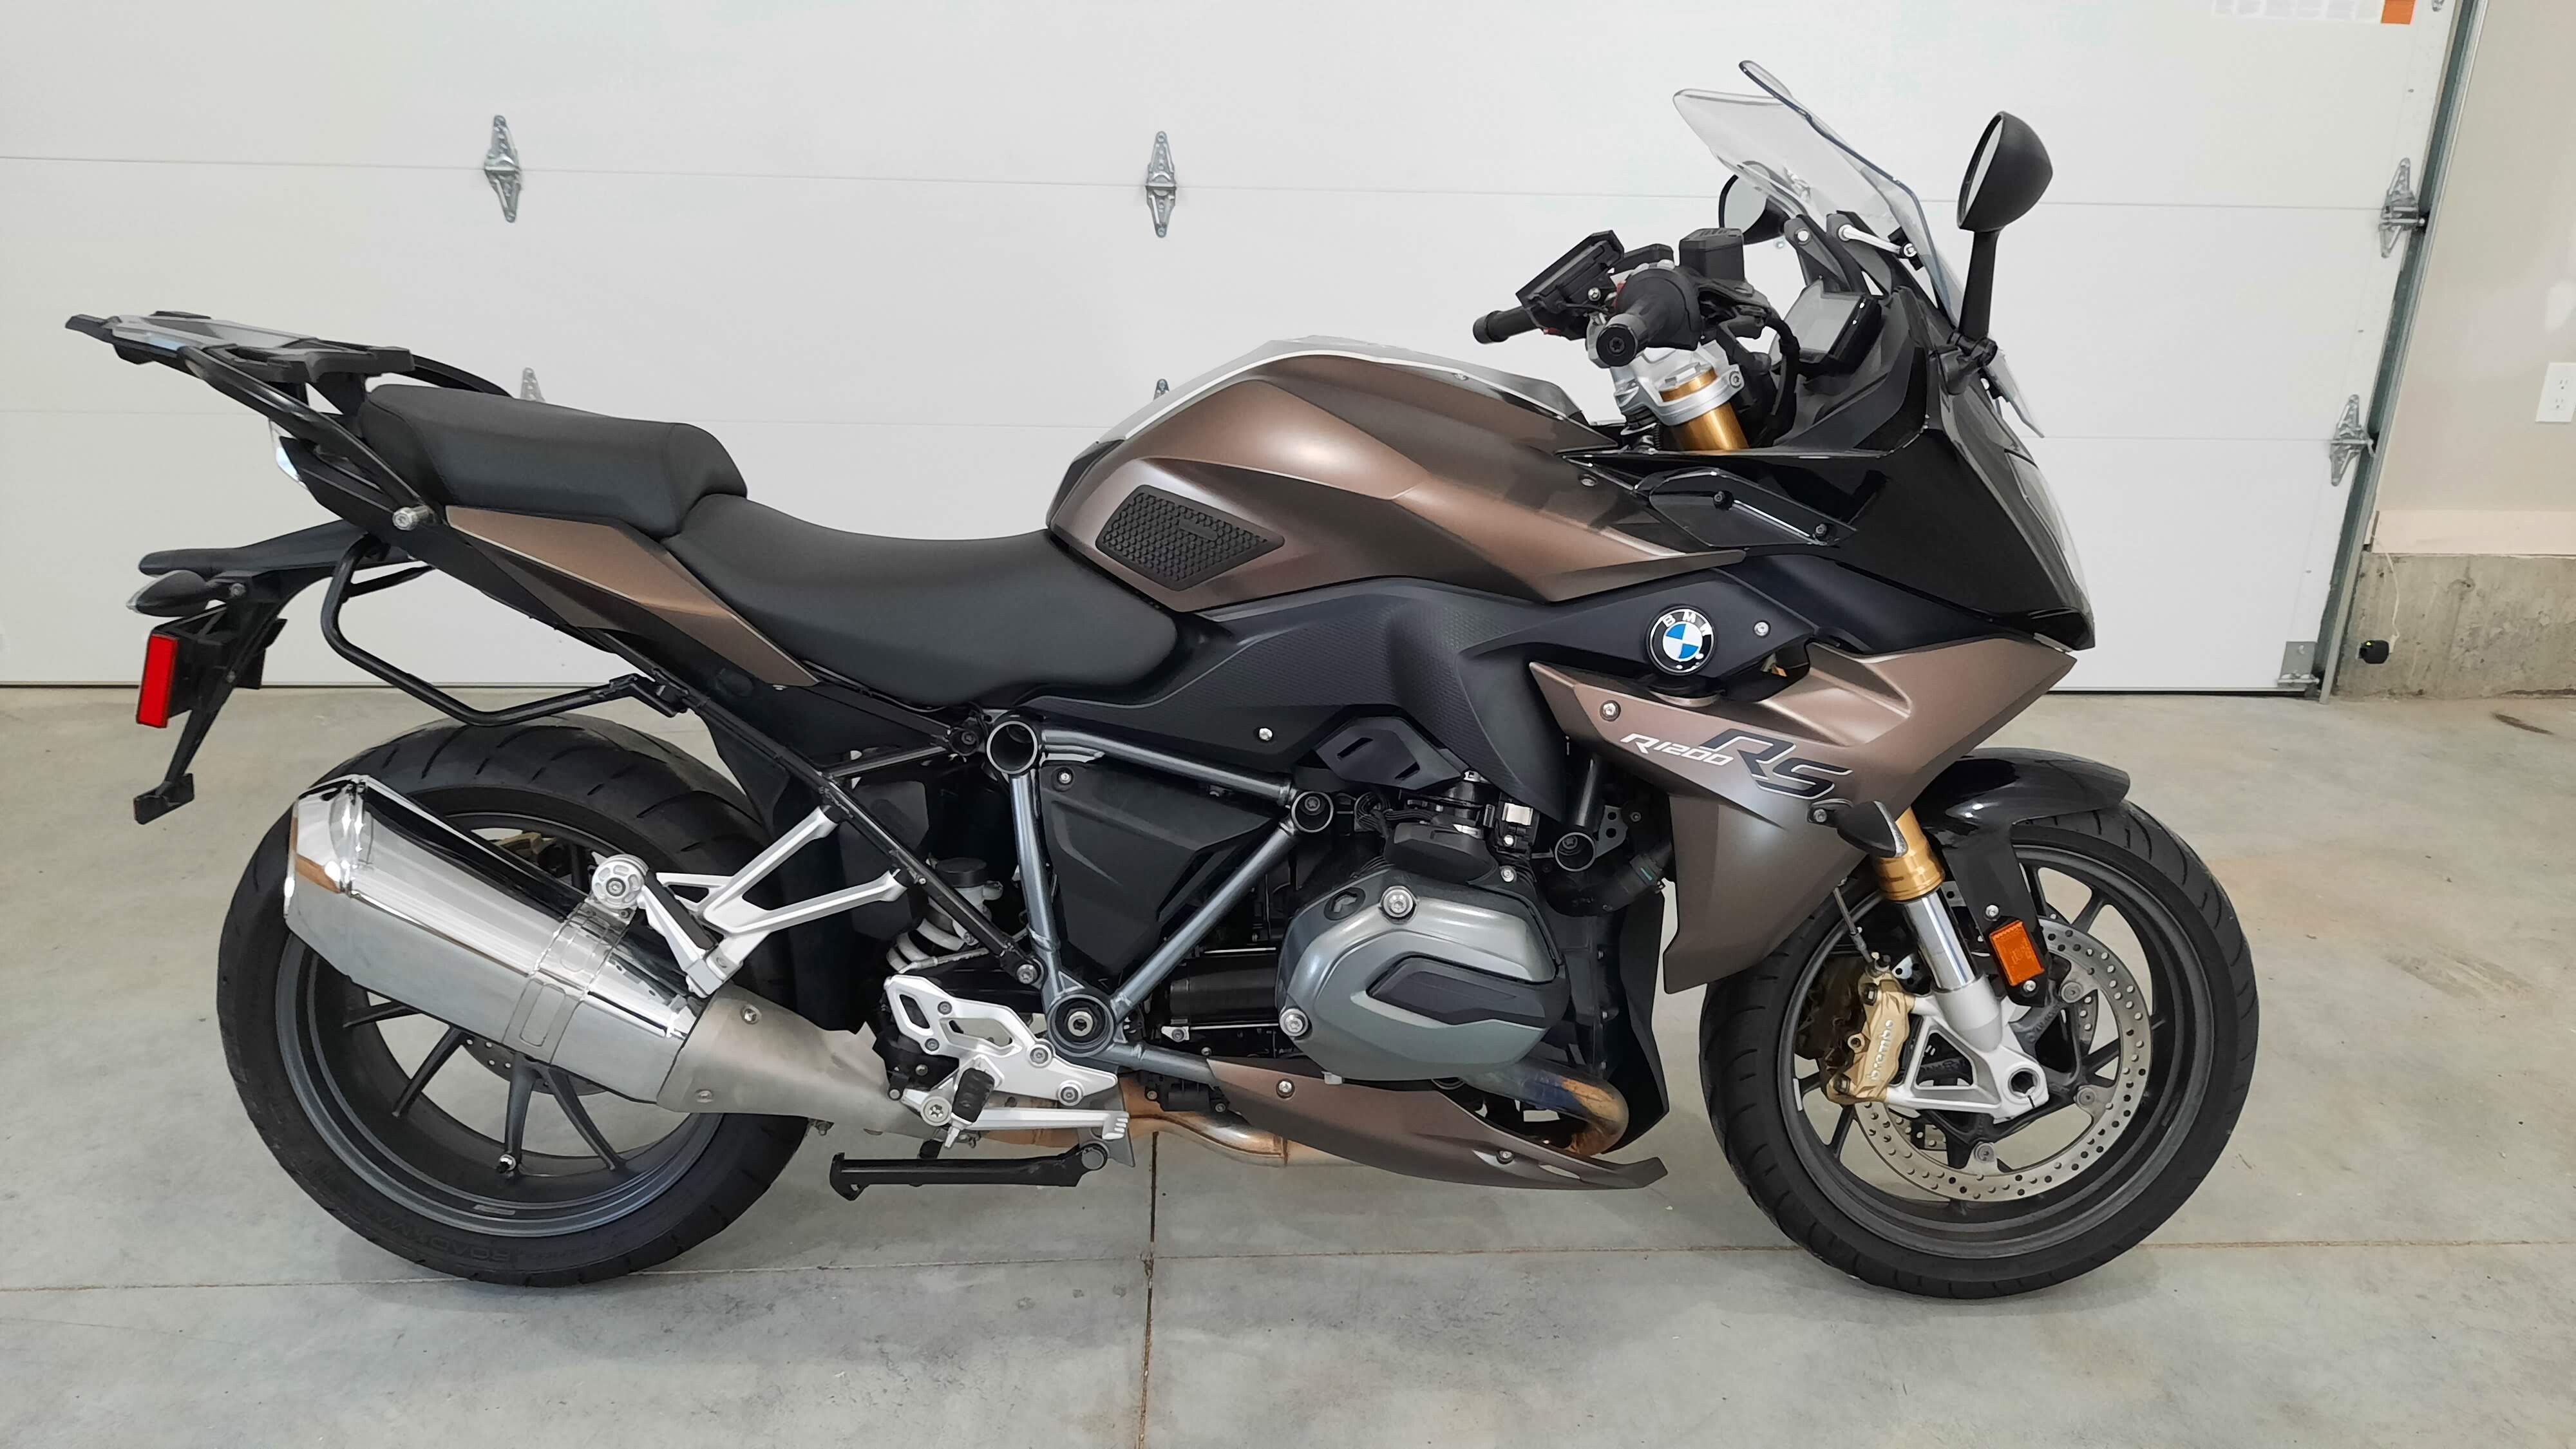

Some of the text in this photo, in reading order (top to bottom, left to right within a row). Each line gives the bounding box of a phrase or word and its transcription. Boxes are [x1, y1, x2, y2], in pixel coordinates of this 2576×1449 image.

[1662, 611, 1712, 636] BMW
[1698, 728, 1853, 800] RS
[1866, 1019, 1894, 1081] brembo
